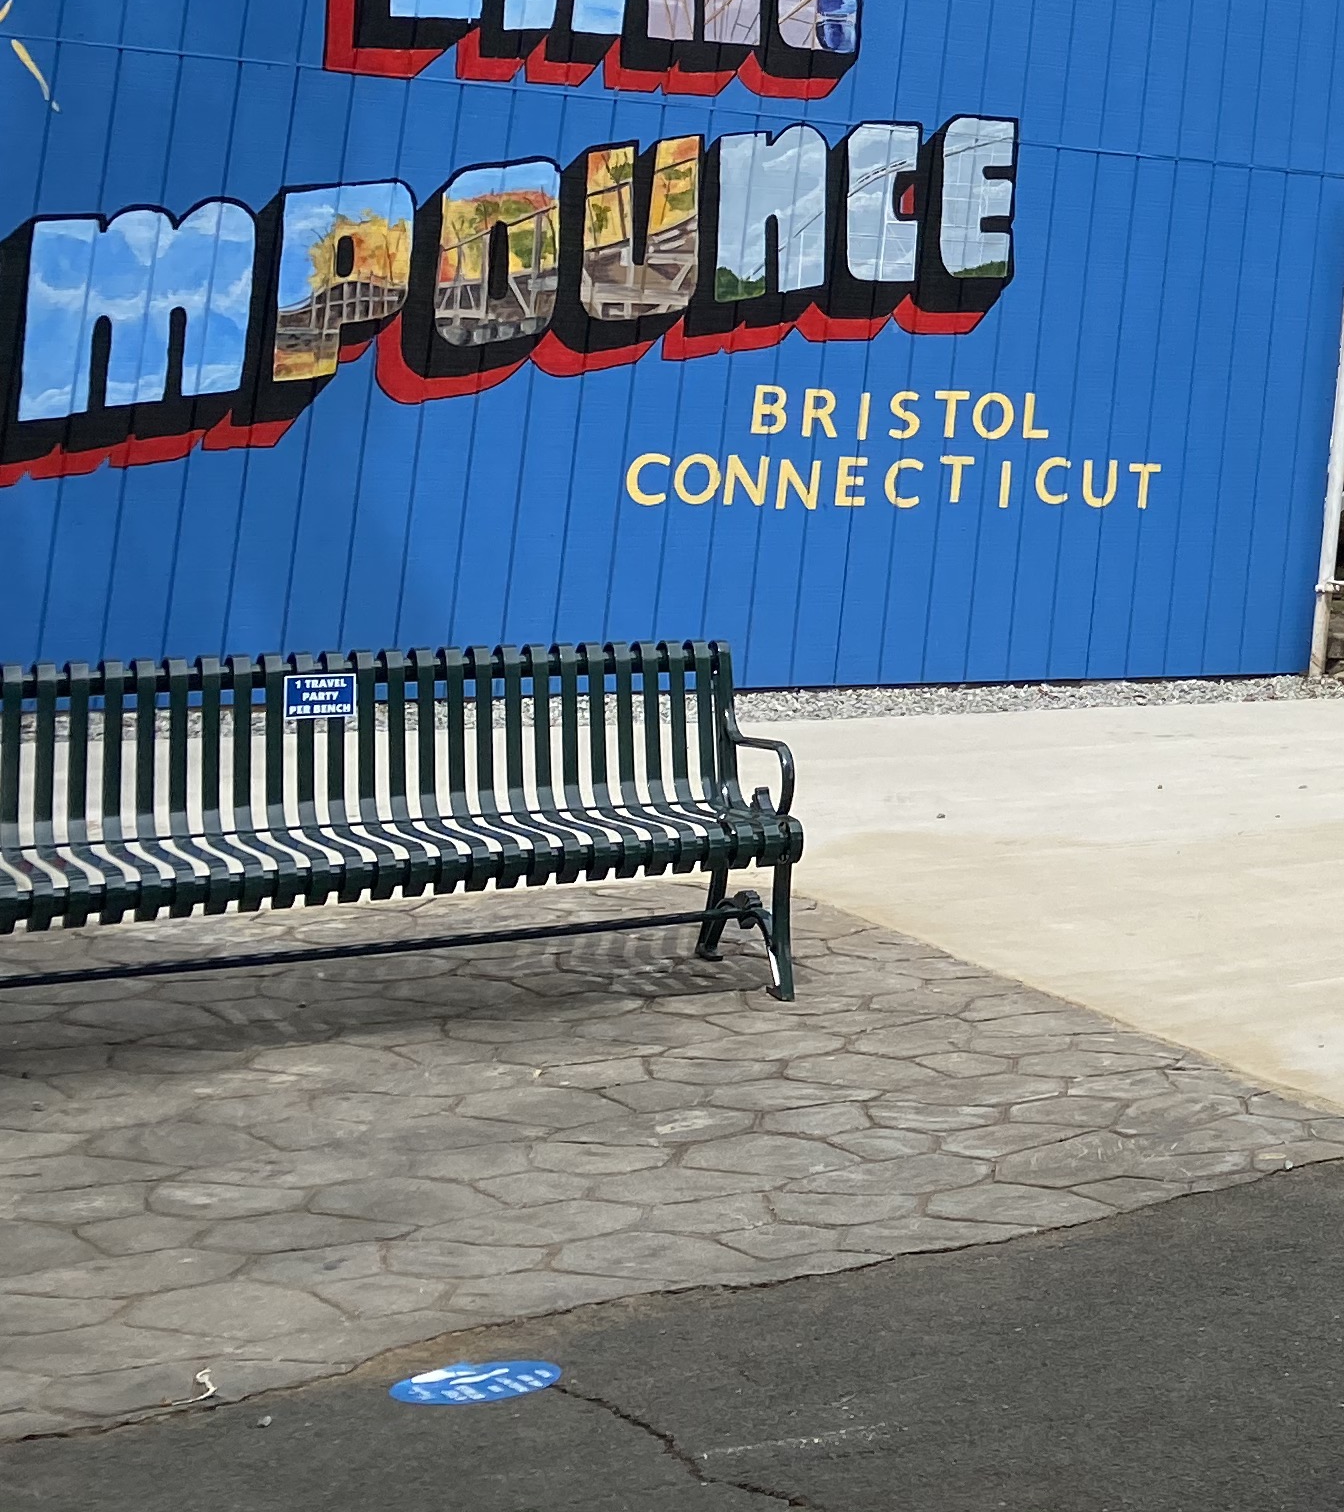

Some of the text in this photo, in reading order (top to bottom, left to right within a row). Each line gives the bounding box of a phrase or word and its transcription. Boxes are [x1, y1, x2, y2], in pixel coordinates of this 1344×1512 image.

[750, 384, 1049, 440] BRISTOL
[626, 452, 1161, 510] CONNECTICUT
[295, 678, 347, 689] 1 TRAVEL
[302, 691, 339, 701] PARTY
[288, 703, 351, 715] PER BENCH
